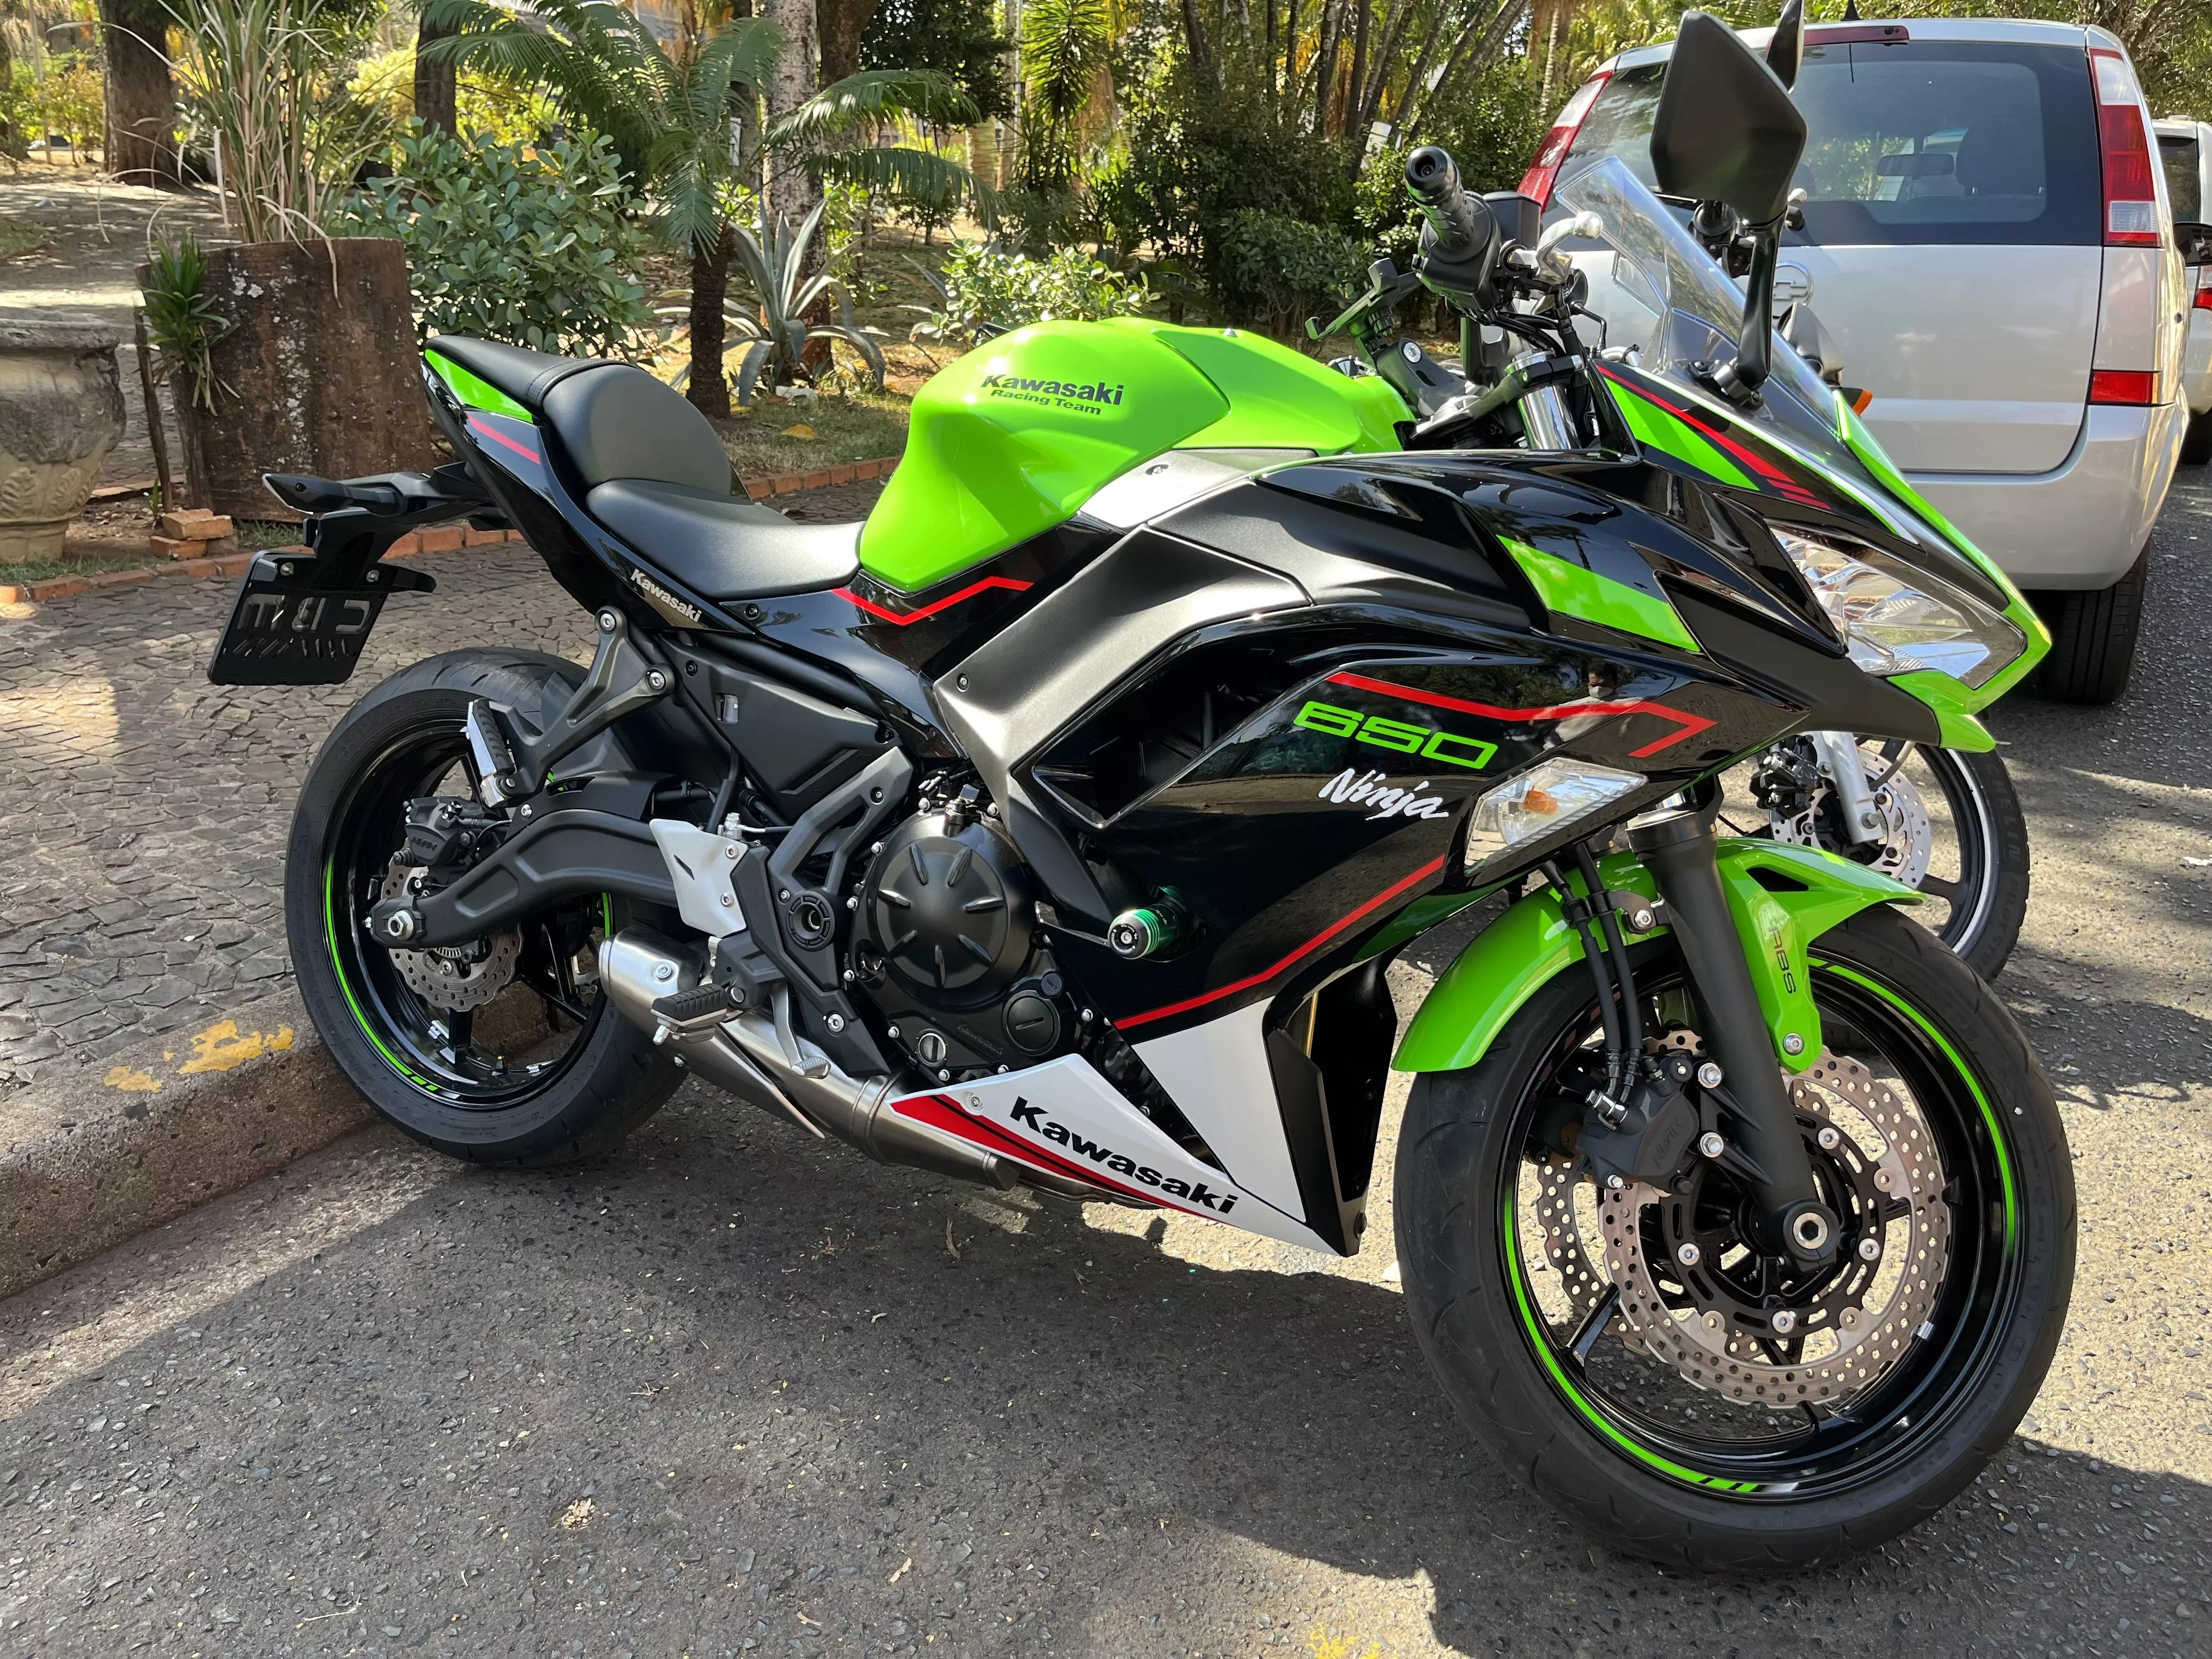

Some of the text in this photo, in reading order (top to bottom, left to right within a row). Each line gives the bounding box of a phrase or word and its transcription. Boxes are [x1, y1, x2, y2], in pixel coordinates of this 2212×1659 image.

[981, 374, 1124, 405] Kawasaki
[990, 389, 1102, 415] Racing Team
[630, 568, 703, 623] Kawasaki
[1293, 701, 1498, 770] 650
[1318, 768, 1449, 821] Ninja
[1987, 763, 2022, 864] CHELIN
[1768, 926, 1796, 994] ABS
[1009, 1096, 1238, 1214] Kawasaki
